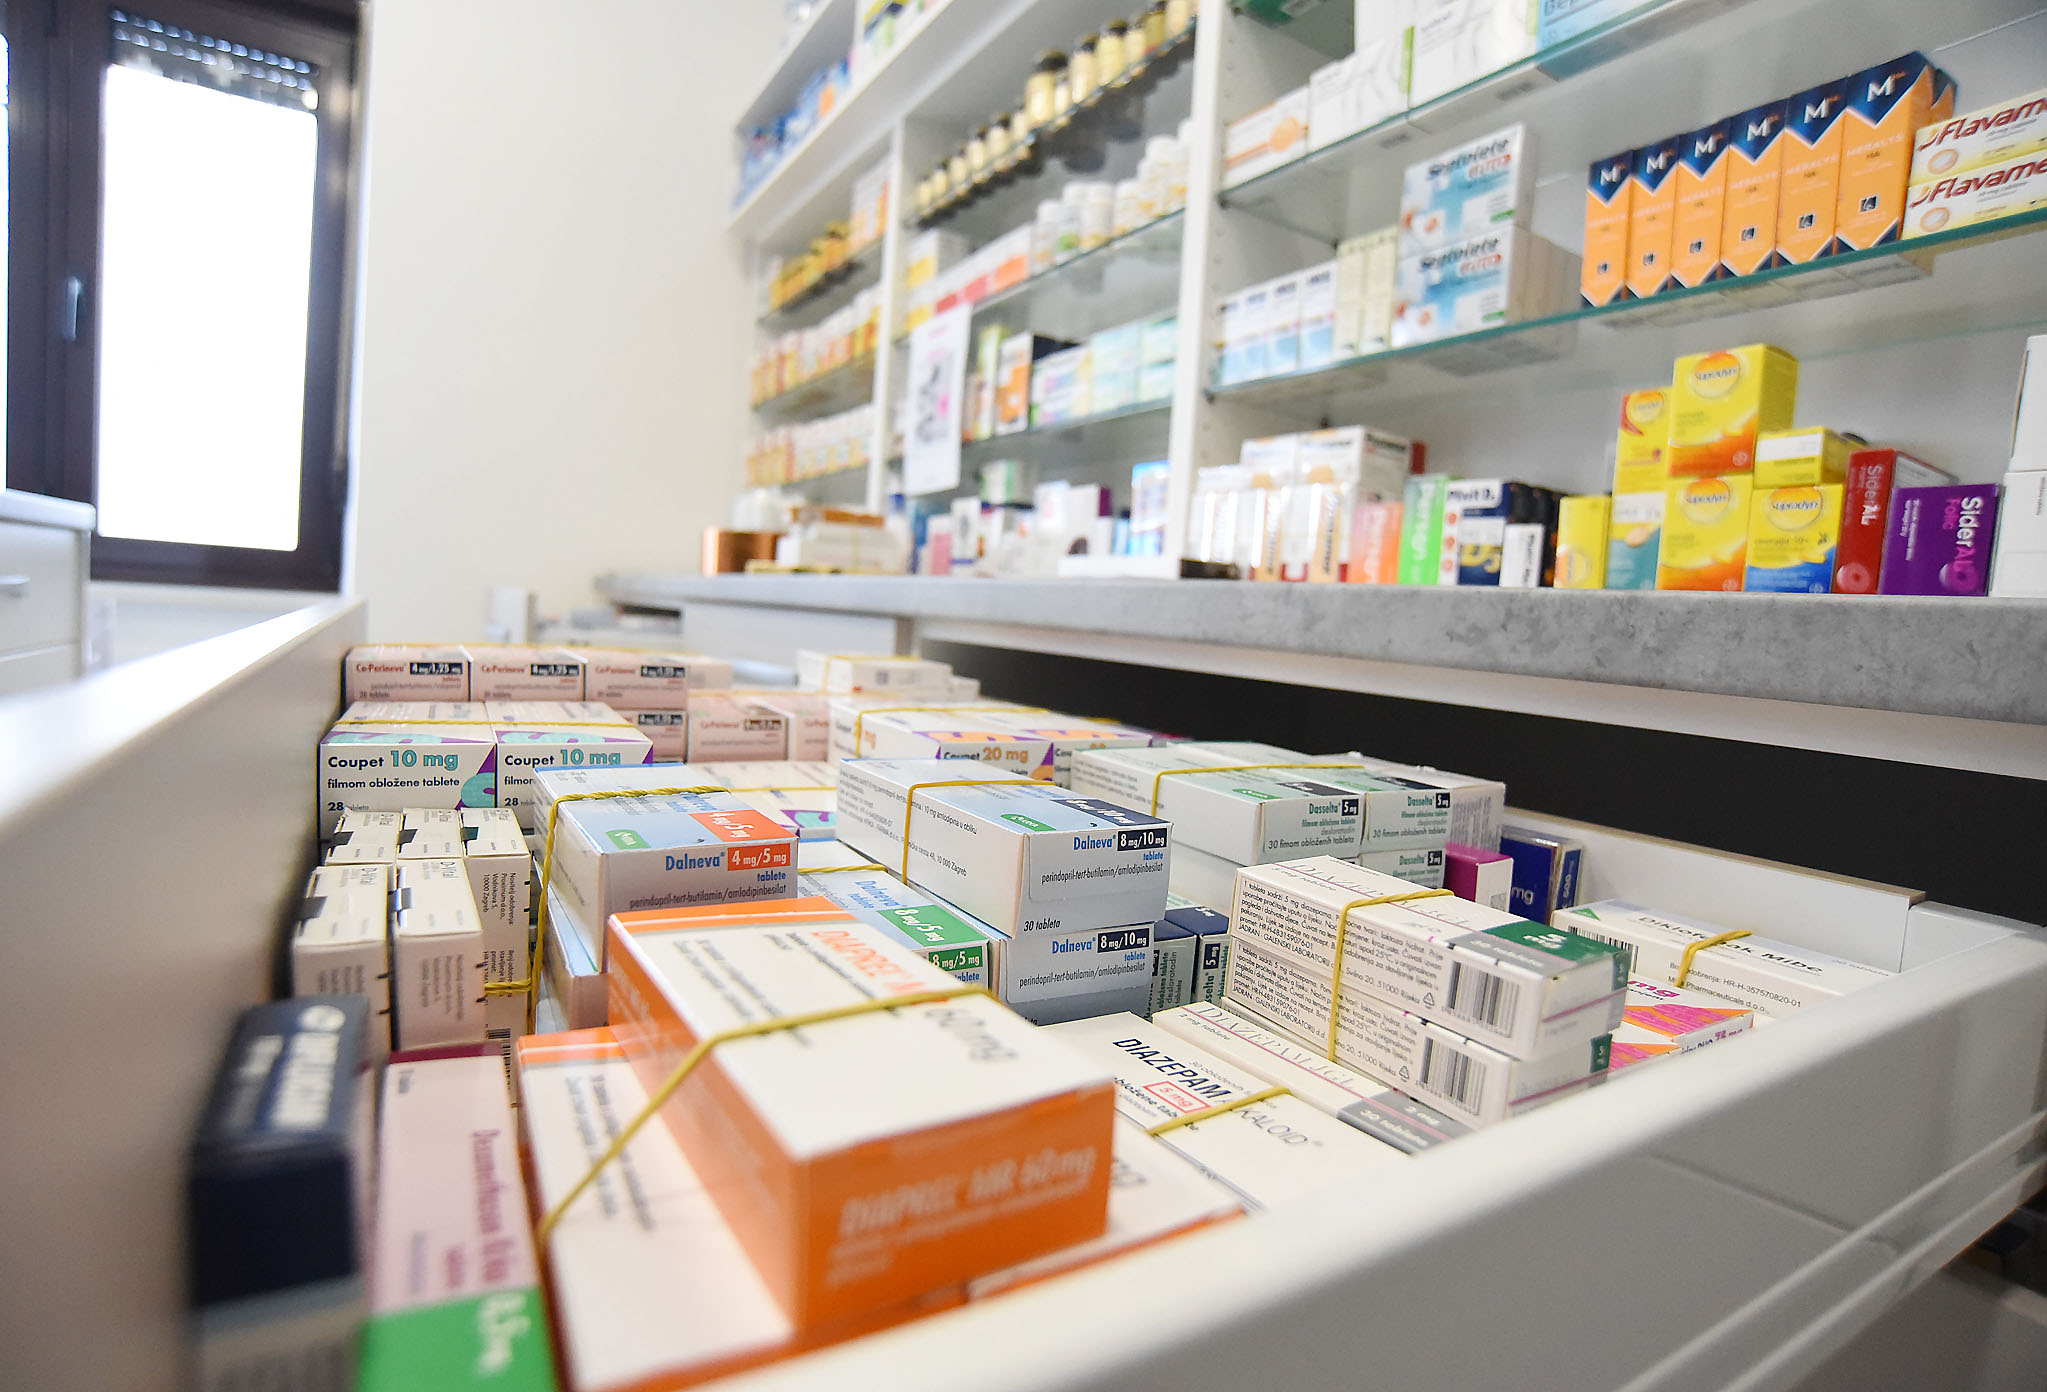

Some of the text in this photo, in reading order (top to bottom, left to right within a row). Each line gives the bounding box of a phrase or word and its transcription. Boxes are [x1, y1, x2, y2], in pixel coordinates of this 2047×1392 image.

[1936, 97, 2047, 145] Flavam
[328, 750, 459, 771] Coupet 10 mg
[504, 749, 622, 768] Coupet 10 mg
[983, 746, 1002, 760] 20
[1006, 749, 1029, 763] mg
[327, 776, 460, 789] filmom obložene tablete
[328, 802, 344, 811] 28
[504, 797, 519, 807] 28
[1308, 801, 1340, 815] Dasselta
[1343, 801, 1349, 813] 5
[1073, 834, 1113, 850] Dalneva
[1120, 832, 1127, 847] 8
[1154, 835, 1165, 848] mg
[1268, 840, 1279, 850] 30
[665, 848, 787, 871] Dalneva 4 mg/5 mg
[1143, 851, 1164, 861] tablete
[757, 870, 787, 882] tablete
[1511, 887, 1534, 905] mg
[1023, 917, 1061, 932] 30 tableta
[1052, 938, 1093, 954] Dalneva
[1100, 935, 1107, 949] 8
[1136, 935, 1147, 947] mg
[932, 954, 940, 967] 8
[967, 955, 980, 966] mg
[1124, 951, 1146, 962] tablete
[1203, 974, 1214, 1003] sselta
[1112, 1038, 1232, 1099] DIAZEPAM
[1169, 1093, 1194, 1107] mg
